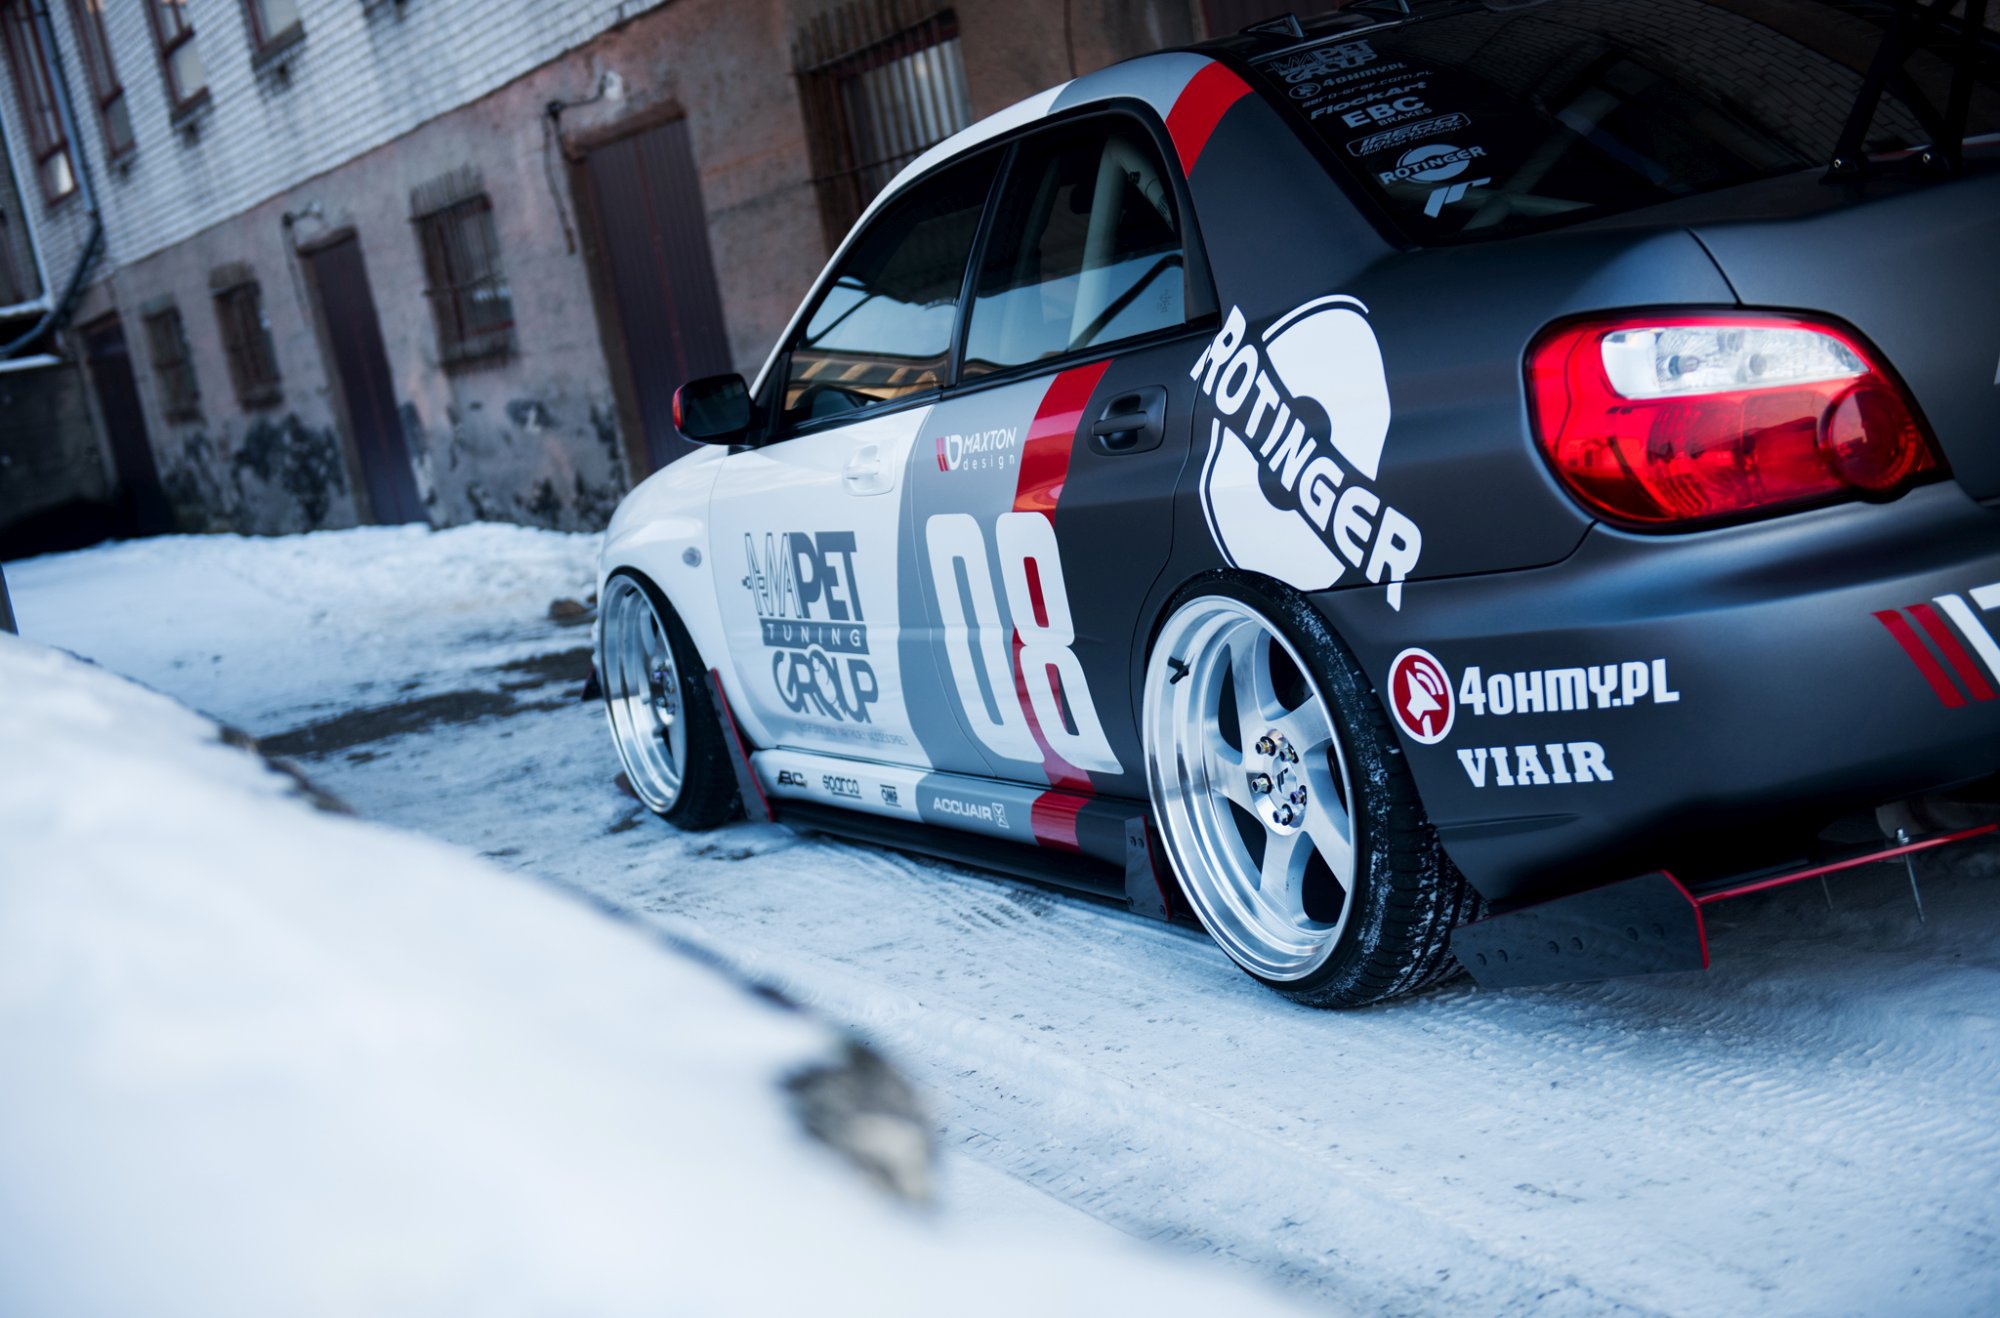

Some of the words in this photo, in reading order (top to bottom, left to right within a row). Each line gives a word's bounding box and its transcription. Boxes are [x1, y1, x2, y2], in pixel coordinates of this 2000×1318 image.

[1285, 53, 1378, 83] GROUP
[1341, 96, 1424, 129] EBC
[1377, 107, 1433, 127] BRAKES
[1379, 146, 1487, 185] ROTINGER
[963, 426, 1017, 455] MAXTON
[963, 454, 1015, 471] design
[1190, 304, 1422, 612] ROTINGER
[766, 622, 862, 647] TUNING
[926, 511, 1124, 775] 08
[772, 649, 879, 724] GROUP
[1457, 741, 1614, 788] VIAIR
[822, 774, 861, 796] sparco
[933, 796, 993, 822] ACCUAIR
